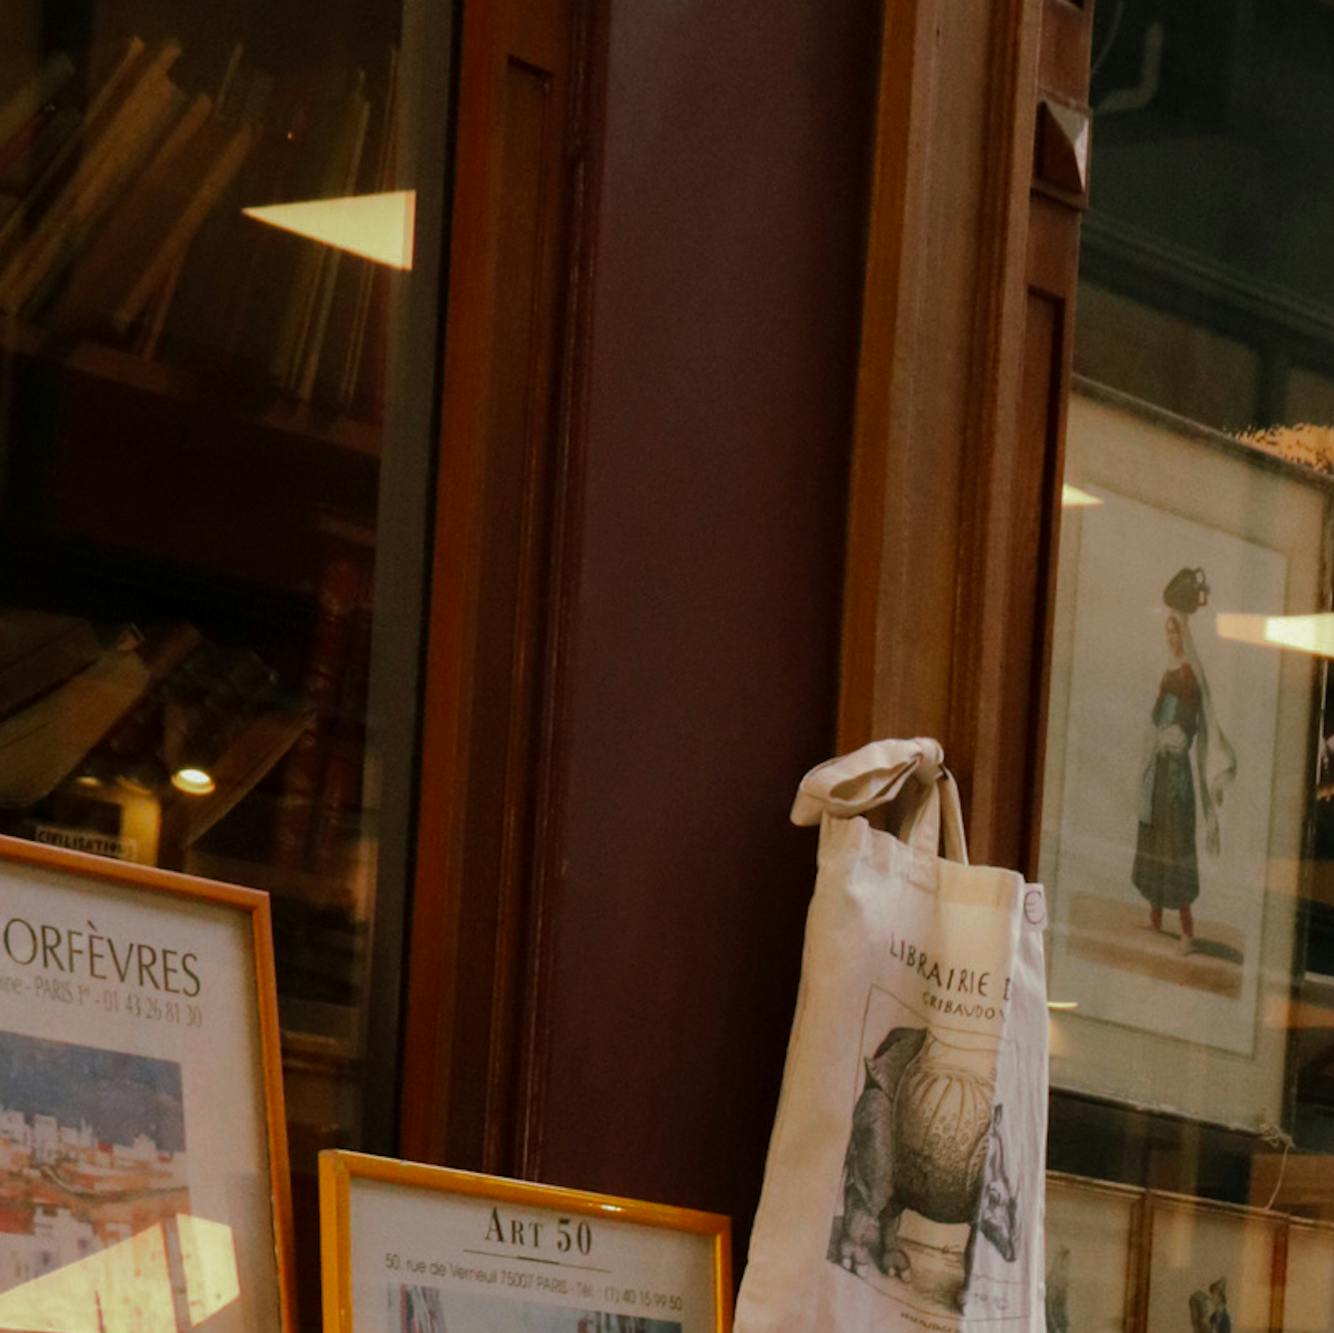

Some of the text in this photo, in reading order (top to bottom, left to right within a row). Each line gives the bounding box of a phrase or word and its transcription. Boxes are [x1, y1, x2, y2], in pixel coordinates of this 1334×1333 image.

[3, 917, 201, 998] ORFÈVRES
[889, 931, 991, 998] LIBRAIRIE
[556, 1217, 593, 1256] 50
